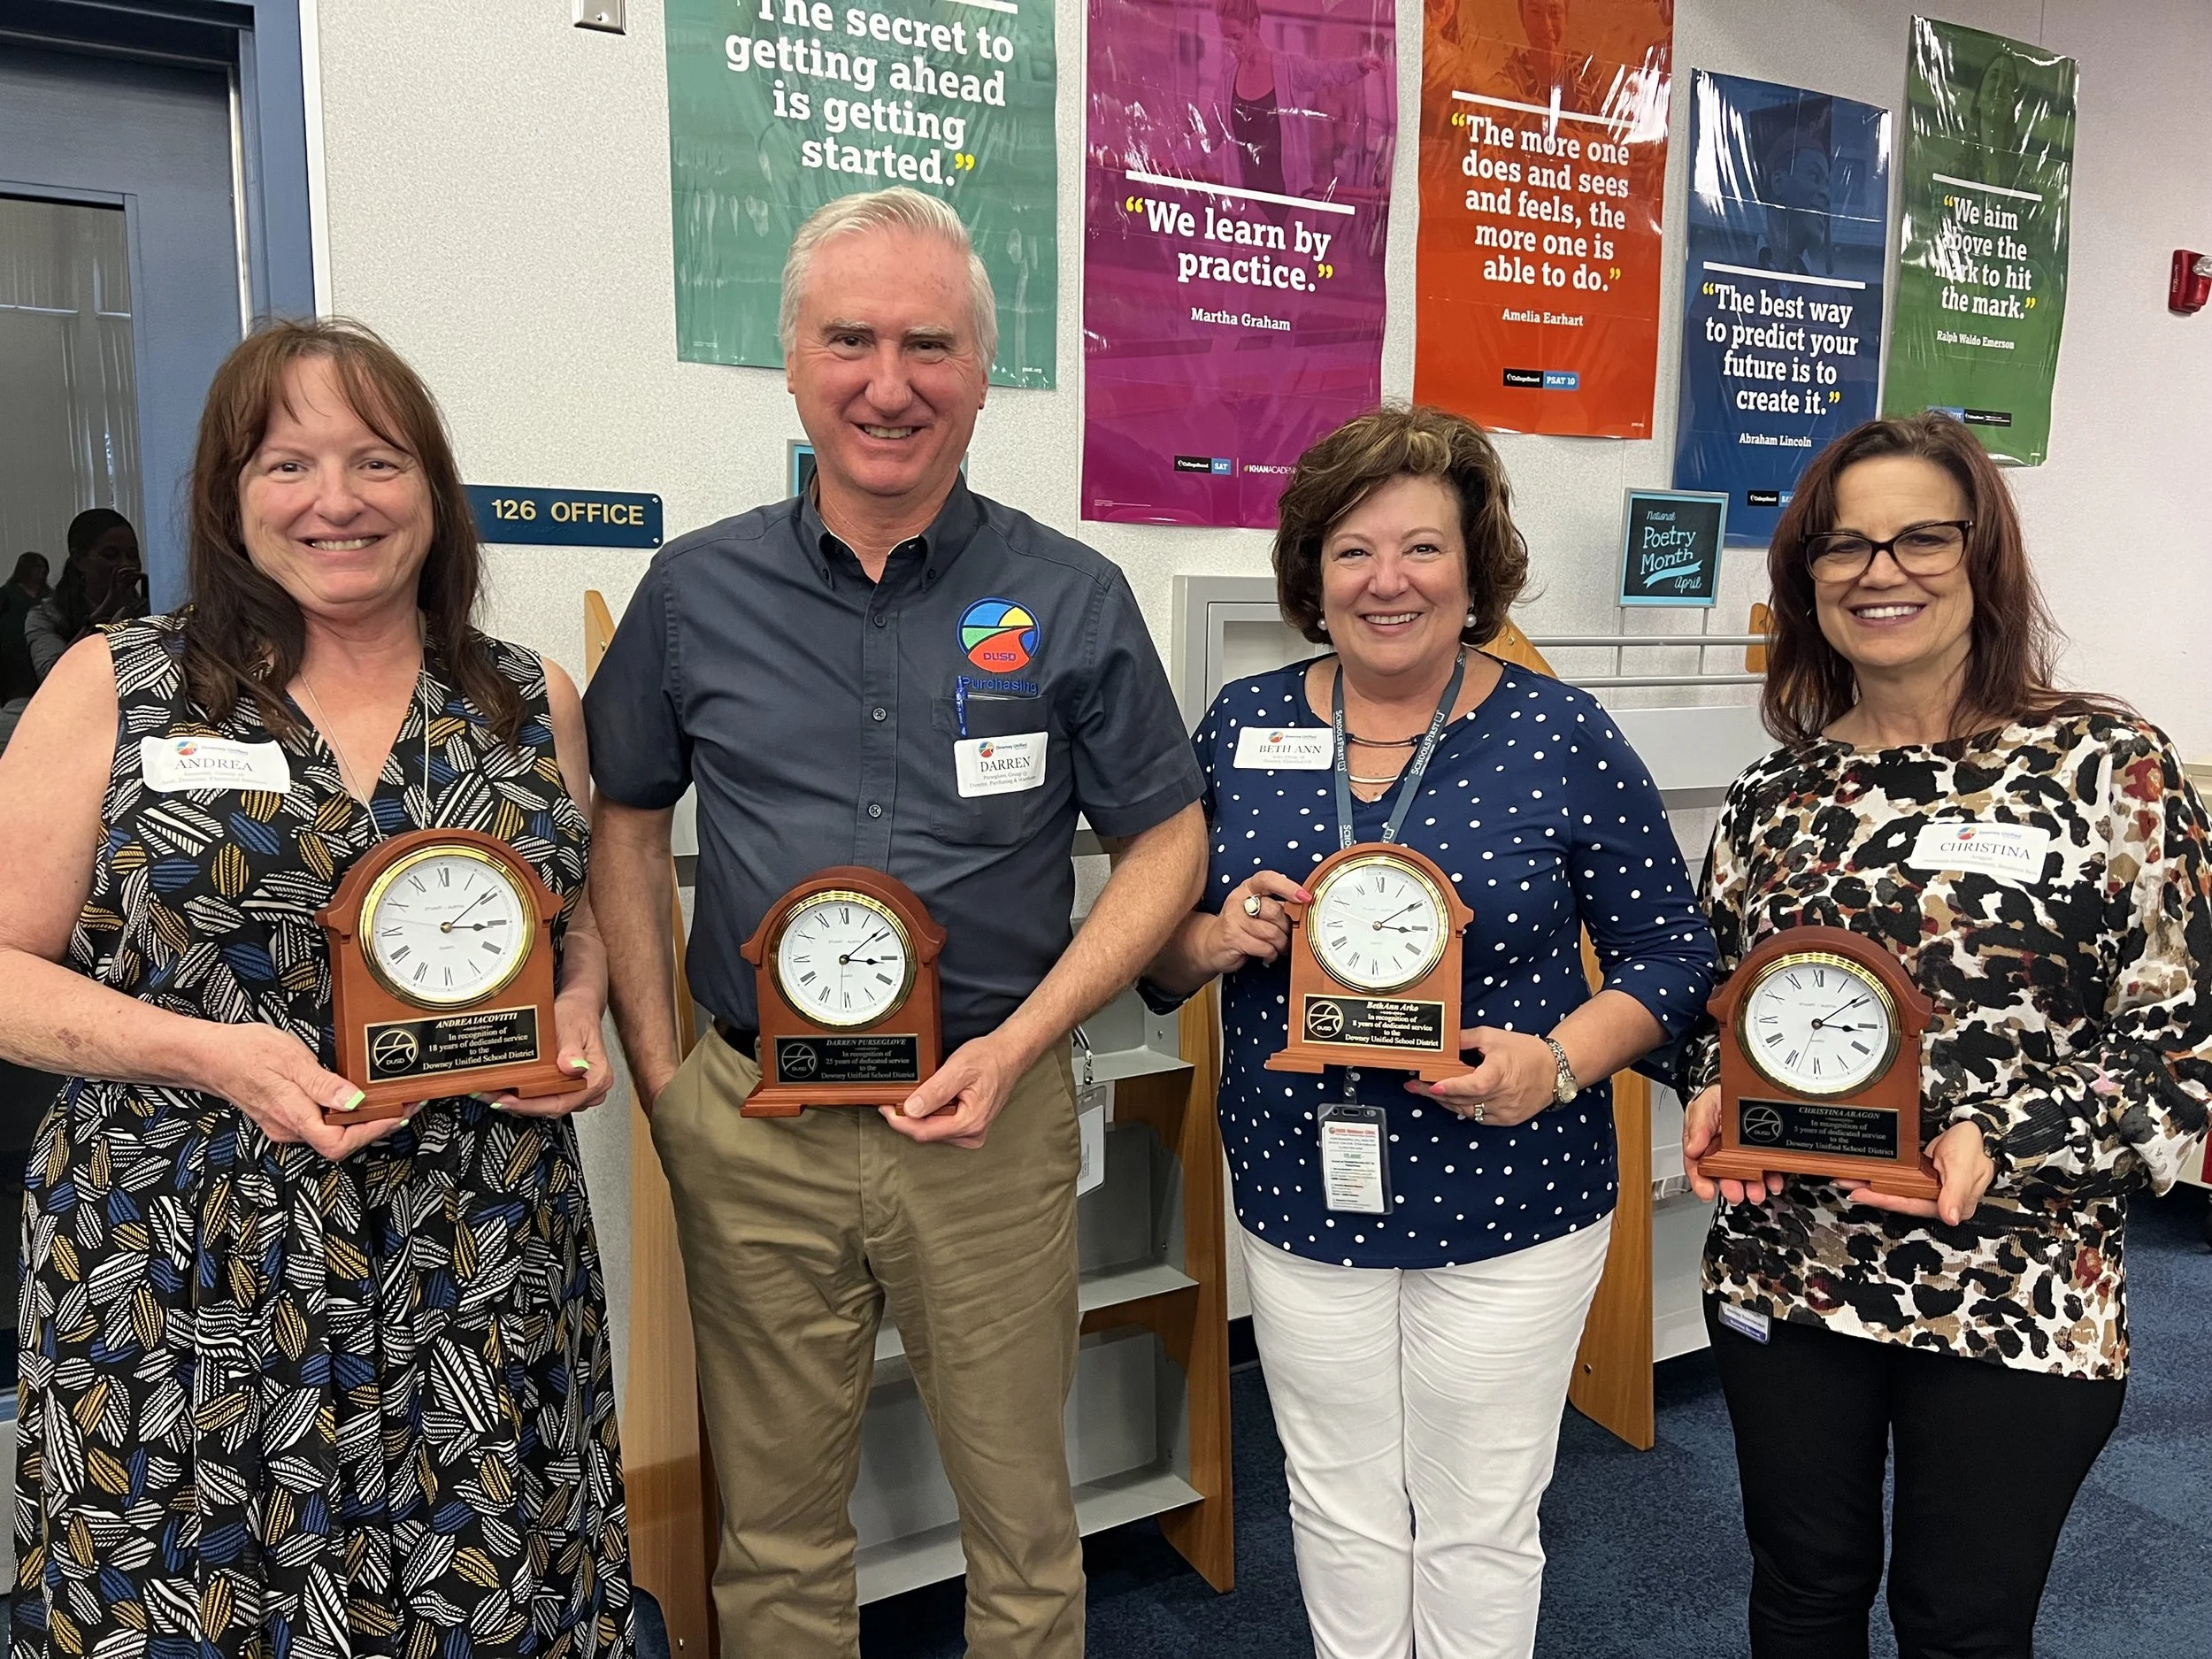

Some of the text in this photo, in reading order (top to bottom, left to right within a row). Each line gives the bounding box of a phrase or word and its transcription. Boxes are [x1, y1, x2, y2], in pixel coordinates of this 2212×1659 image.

[846, 7, 967, 55] secret
[977, 26, 1014, 63] to
[725, 35, 1006, 107] getting ahead
[772, 79, 966, 150] is getting
[1451, 112, 1630, 166] “The more one
[802, 136, 975, 186] started.”
[1462, 150, 1629, 199] does and sees
[1465, 188, 1625, 230] and feels, the
[1944, 195, 2018, 232] “We aim
[1125, 196, 1331, 262] “We learn by
[1474, 224, 1614, 260] more one is
[1943, 229, 2027, 262] above the
[1177, 251, 1333, 292] practice.”
[1483, 256, 1621, 292] able to do.”
[1982, 265, 2000, 288] to
[2005, 265, 2032, 290] hit
[1702, 282, 1853, 329] “The best way
[1941, 286, 2037, 319] the mark.”
[1190, 307, 1291, 331] Martha Graham
[1502, 308, 1584, 326] Amelia Earhart
[1705, 316, 1858, 357] to predict your
[1937, 330, 2015, 349] Ralph Waldo Emerson
[1723, 349, 1837, 385] future is to
[1736, 388, 1840, 415] create it.”
[1739, 432, 1812, 448] Abraham Lincoln
[491, 499, 644, 526] 126 OFFICE
[1642, 526, 1696, 549] Poetry
[1640, 549, 1694, 575] Month
[983, 652, 1017, 662] DUSD
[1294, 745, 1322, 754] ANN
[175, 757, 253, 772] ANDREA
[980, 757, 1031, 772] DARREN
[1940, 842, 2031, 860] CHRISTINA
[1366, 1002, 1419, 1012] BethAnn Arko
[435, 1012, 518, 1029] ANDREA IACOVITTI
[439, 1043, 458, 1053] years
[469, 1037, 503, 1047] dedicated
[457, 1029, 497, 1041] recognition
[1345, 1033, 1370, 1043] Downey
[1371, 1035, 1394, 1044] Unified
[423, 1049, 534, 1071] Downey Unified School District
[1799, 1106, 1881, 1119] CHRISTINA ARAGON
[1819, 1121, 1858, 1130] recognition
[1827, 1128, 1860, 1138] dedicated
[1786, 1140, 1894, 1156] Downey Unified School District
